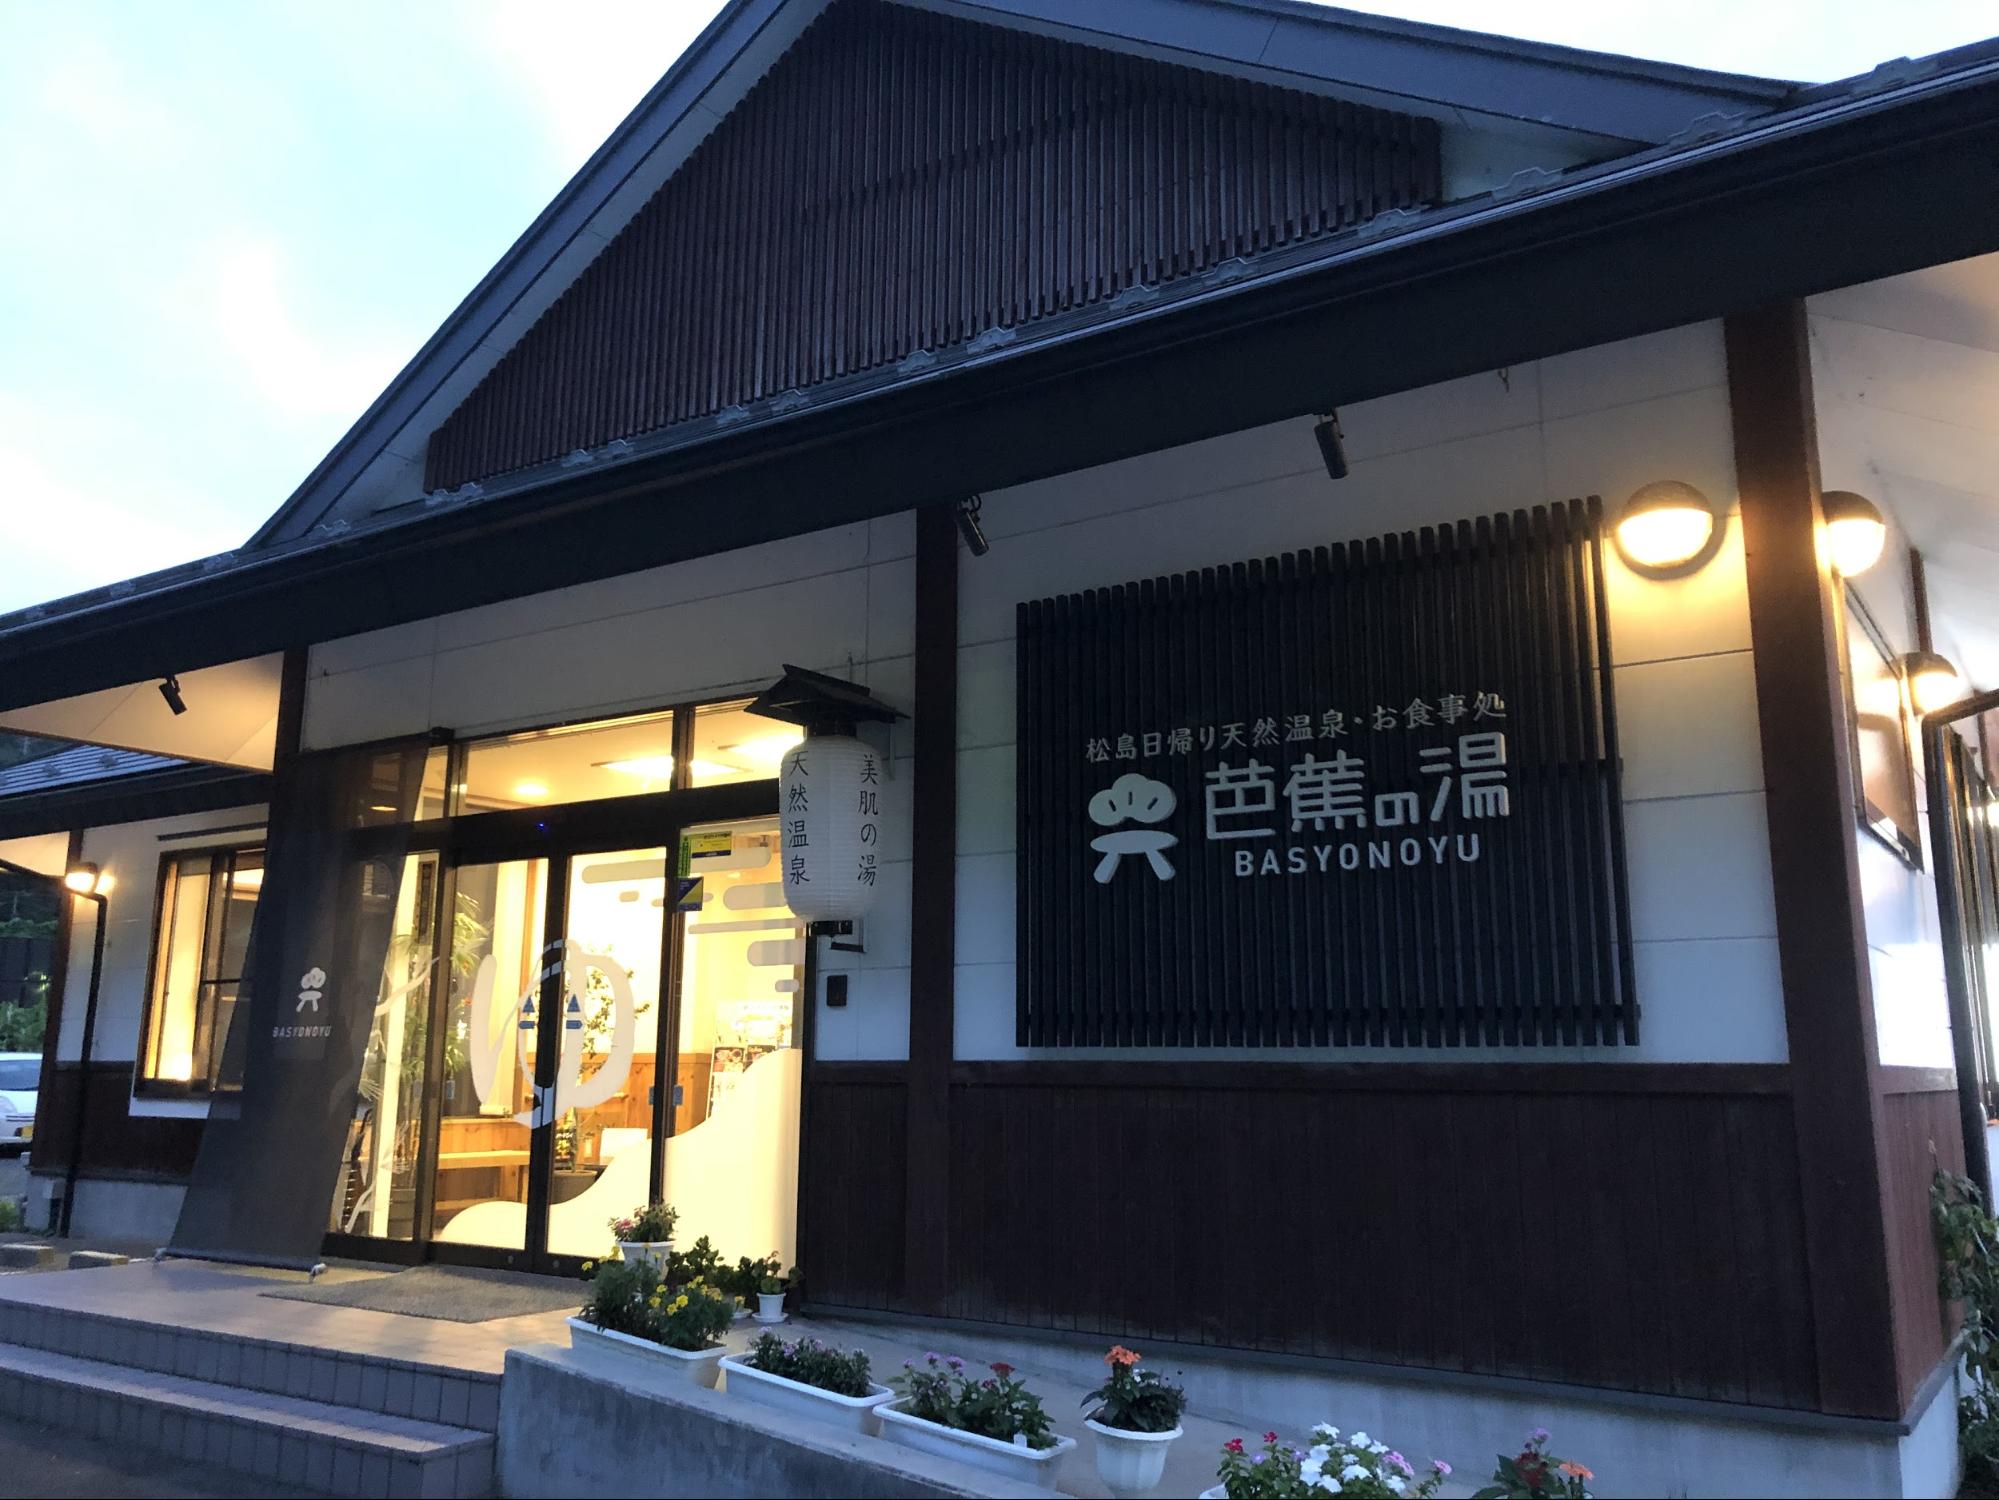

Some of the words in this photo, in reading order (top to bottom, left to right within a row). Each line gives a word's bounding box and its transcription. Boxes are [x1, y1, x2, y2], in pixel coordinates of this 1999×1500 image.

[788, 751, 811, 886] 天然温泉
[857, 754, 879, 888] 美肌の湯
[1204, 731, 1510, 841] 芭蕉の湯
[1234, 833, 1481, 877] BASYONOYU
